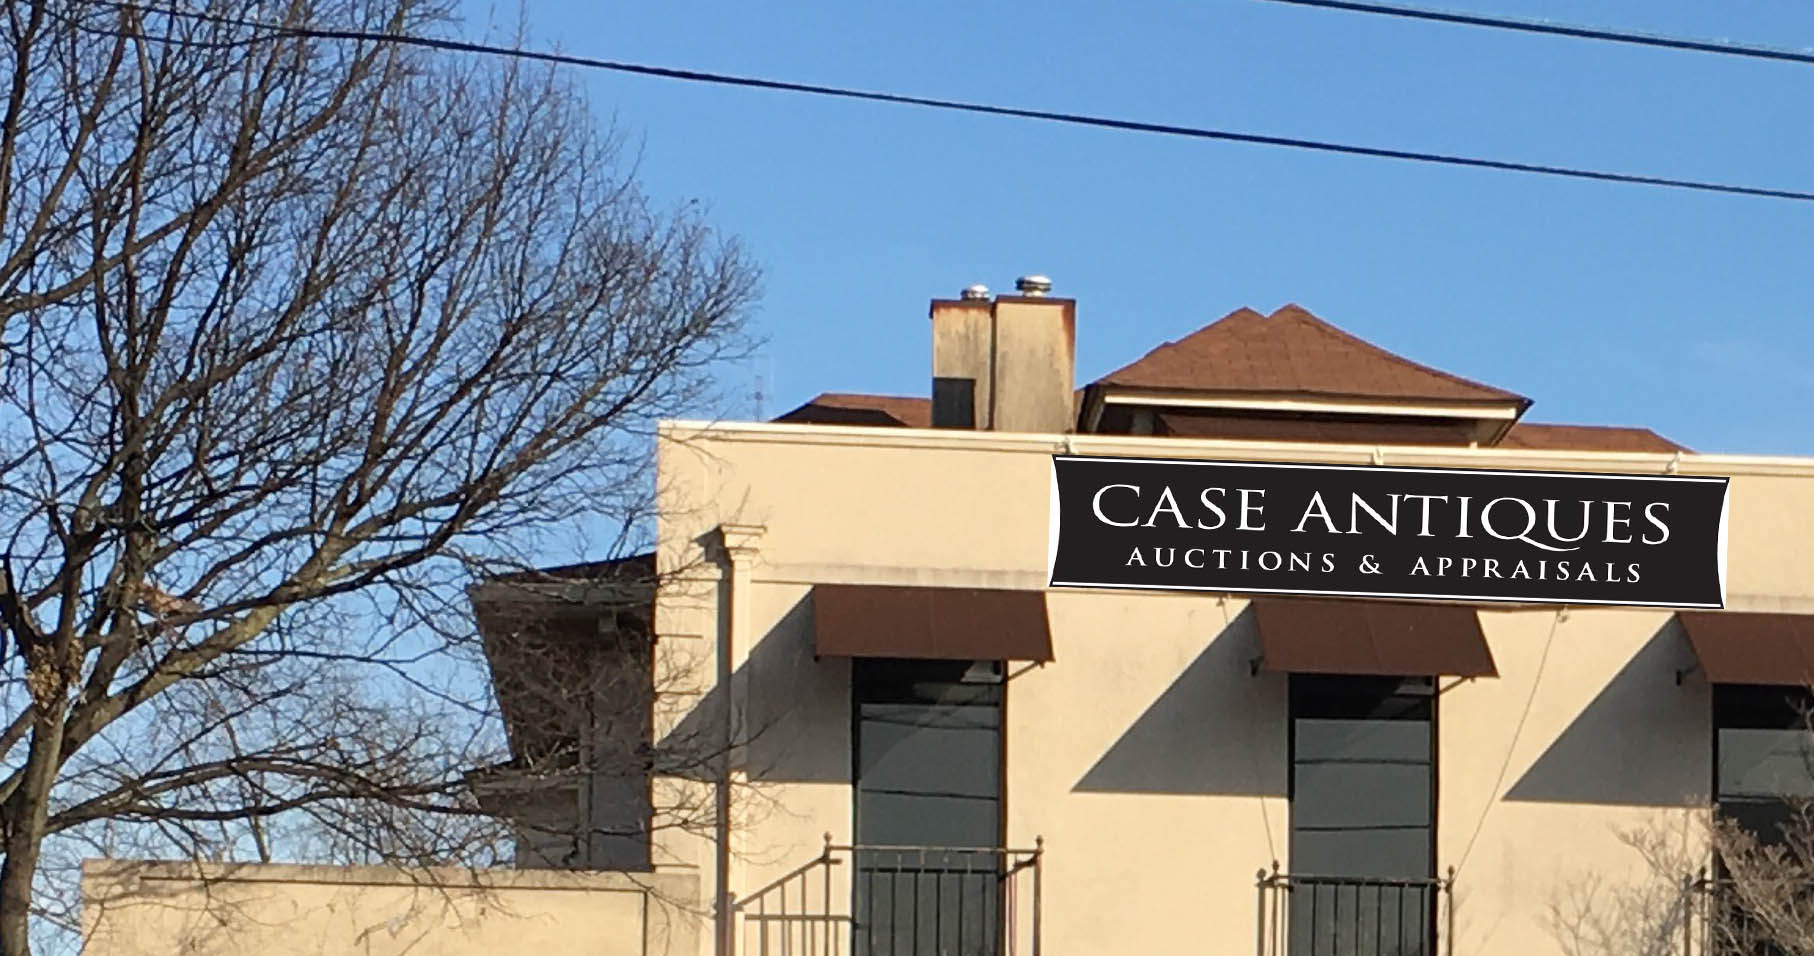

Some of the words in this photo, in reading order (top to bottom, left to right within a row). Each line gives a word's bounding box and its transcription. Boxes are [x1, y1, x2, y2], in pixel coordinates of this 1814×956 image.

[1092, 483, 1266, 531] CASE
[1289, 490, 1671, 552] ANTIQUES
[1125, 546, 1335, 573] AUCTIONS
[1358, 554, 1384, 575] &
[1408, 556, 1640, 583] APPRAISALS
